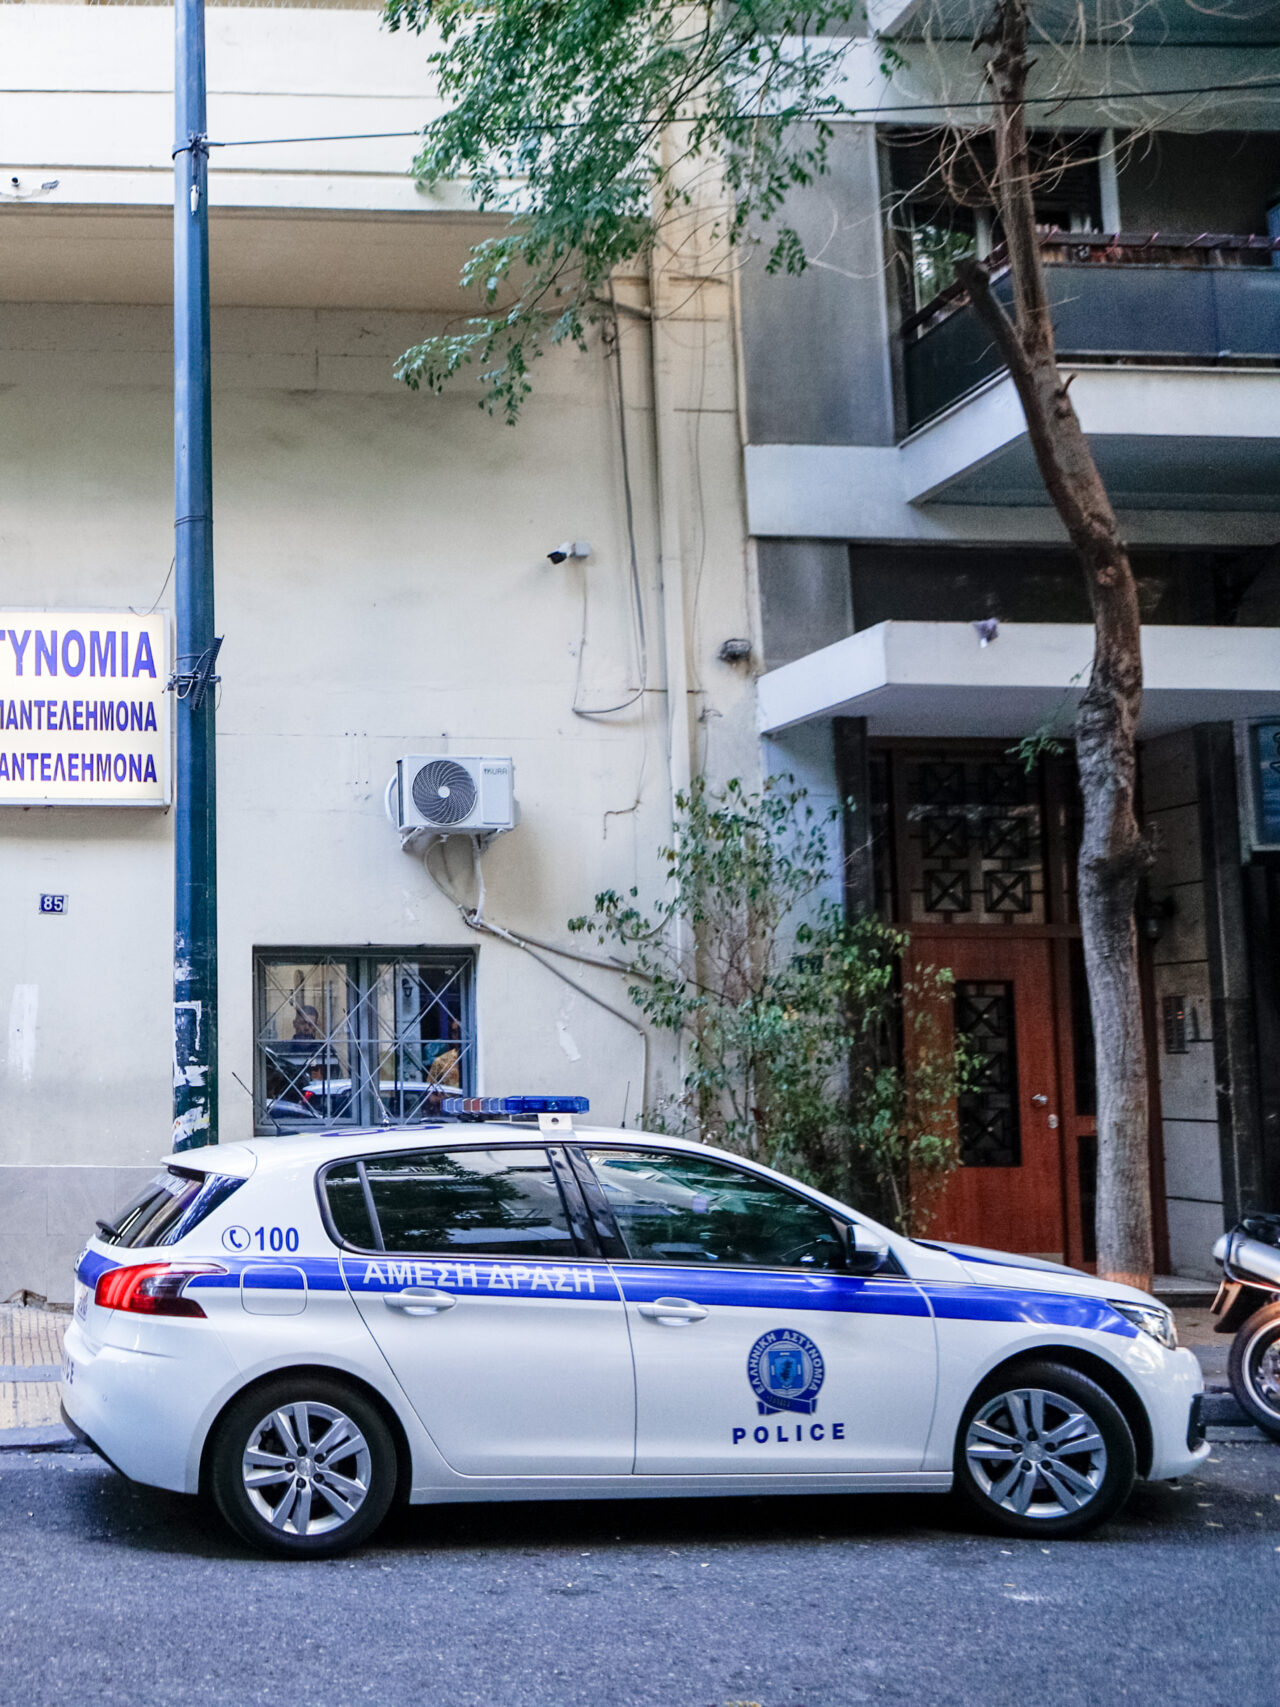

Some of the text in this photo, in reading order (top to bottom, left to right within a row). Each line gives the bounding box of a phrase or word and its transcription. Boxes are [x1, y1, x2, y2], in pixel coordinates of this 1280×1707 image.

[43, 896, 63, 911] 85
[255, 1226, 299, 1252] 100
[363, 1260, 596, 1294] ΑΜΕΣΗ ΔΡΑΣΗ
[749, 1331, 823, 1394] ΕΛΛΗΝΙΚΗ ΑΣΤΥΝΟΜΙΑ
[732, 1423, 845, 1444] POLICE
